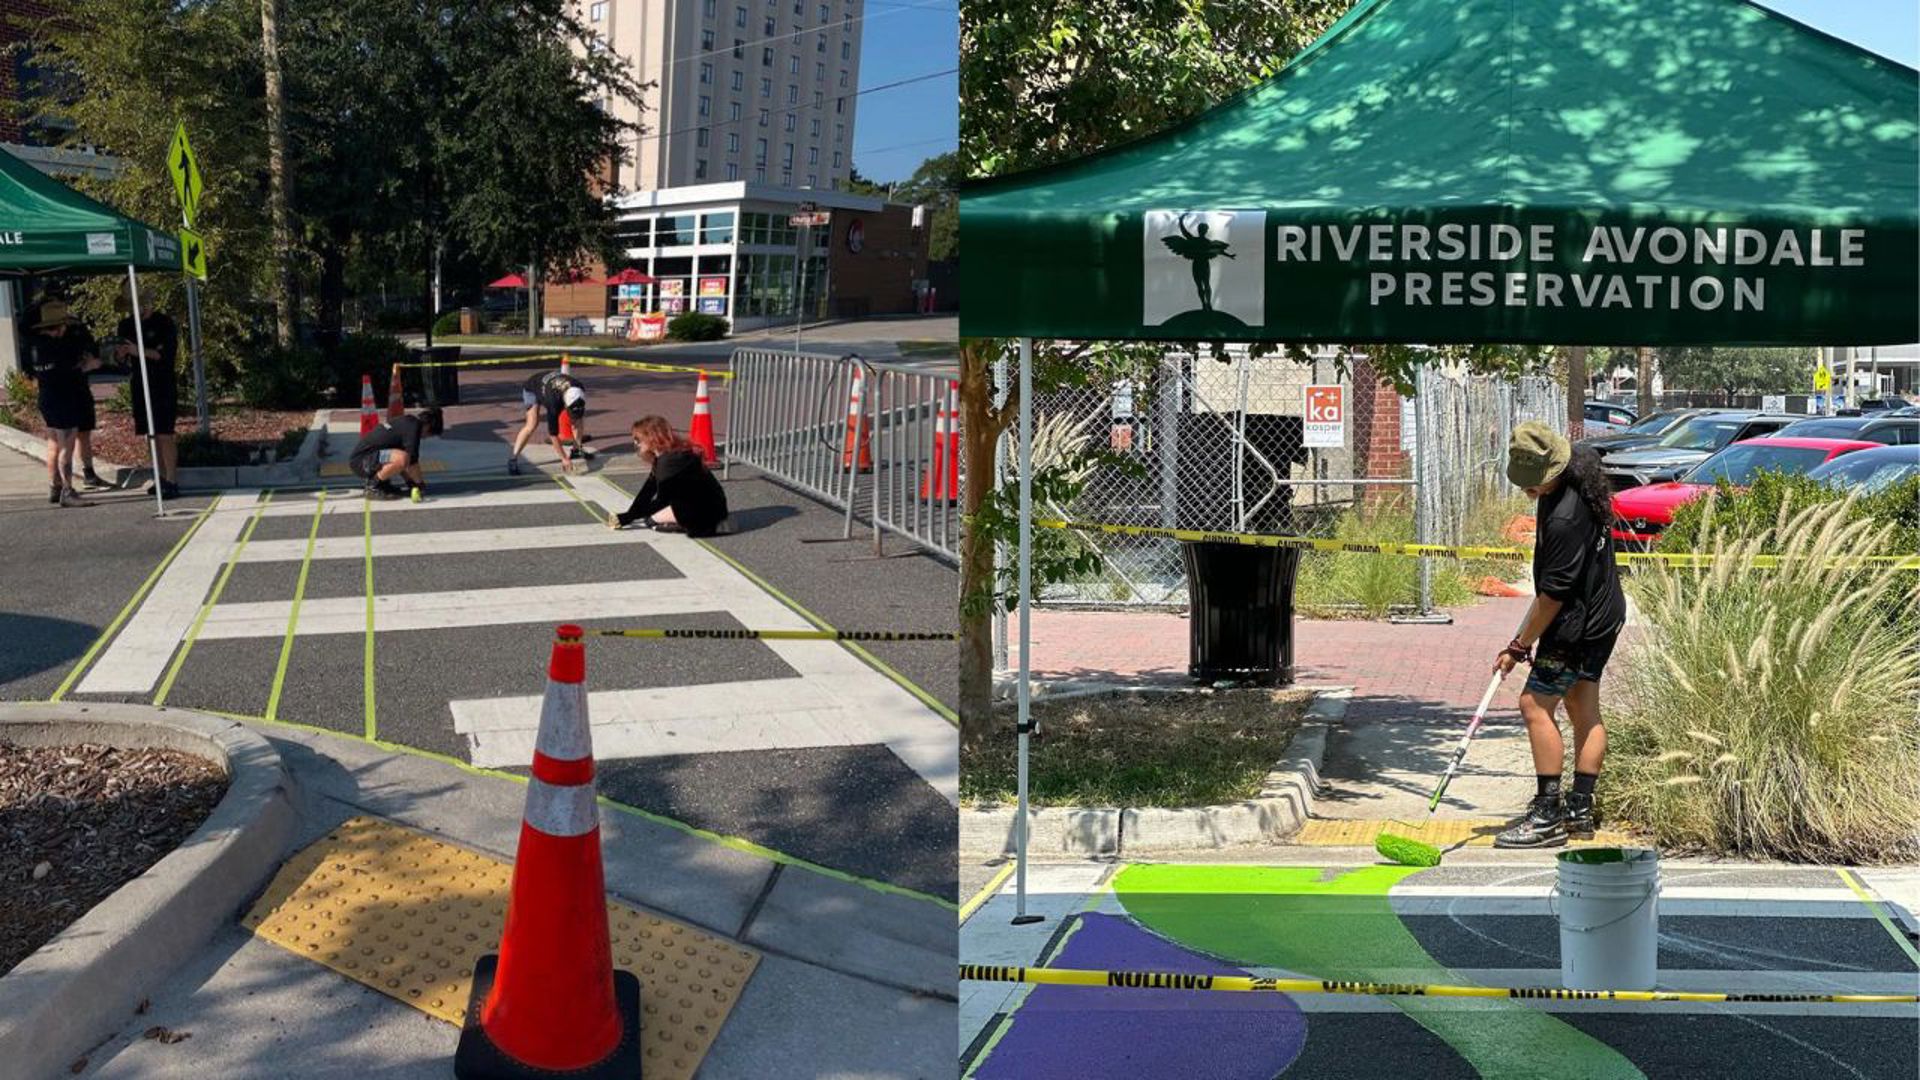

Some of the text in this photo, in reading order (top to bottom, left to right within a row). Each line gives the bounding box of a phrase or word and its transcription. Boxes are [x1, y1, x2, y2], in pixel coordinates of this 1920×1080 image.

[1277, 224, 1866, 266] RIVERSIDE AVONDALE
[1370, 272, 1764, 311] PRESERVATION
[1418, 548, 1457, 558] CAUTION
[1107, 971, 1214, 990] CAUTION
